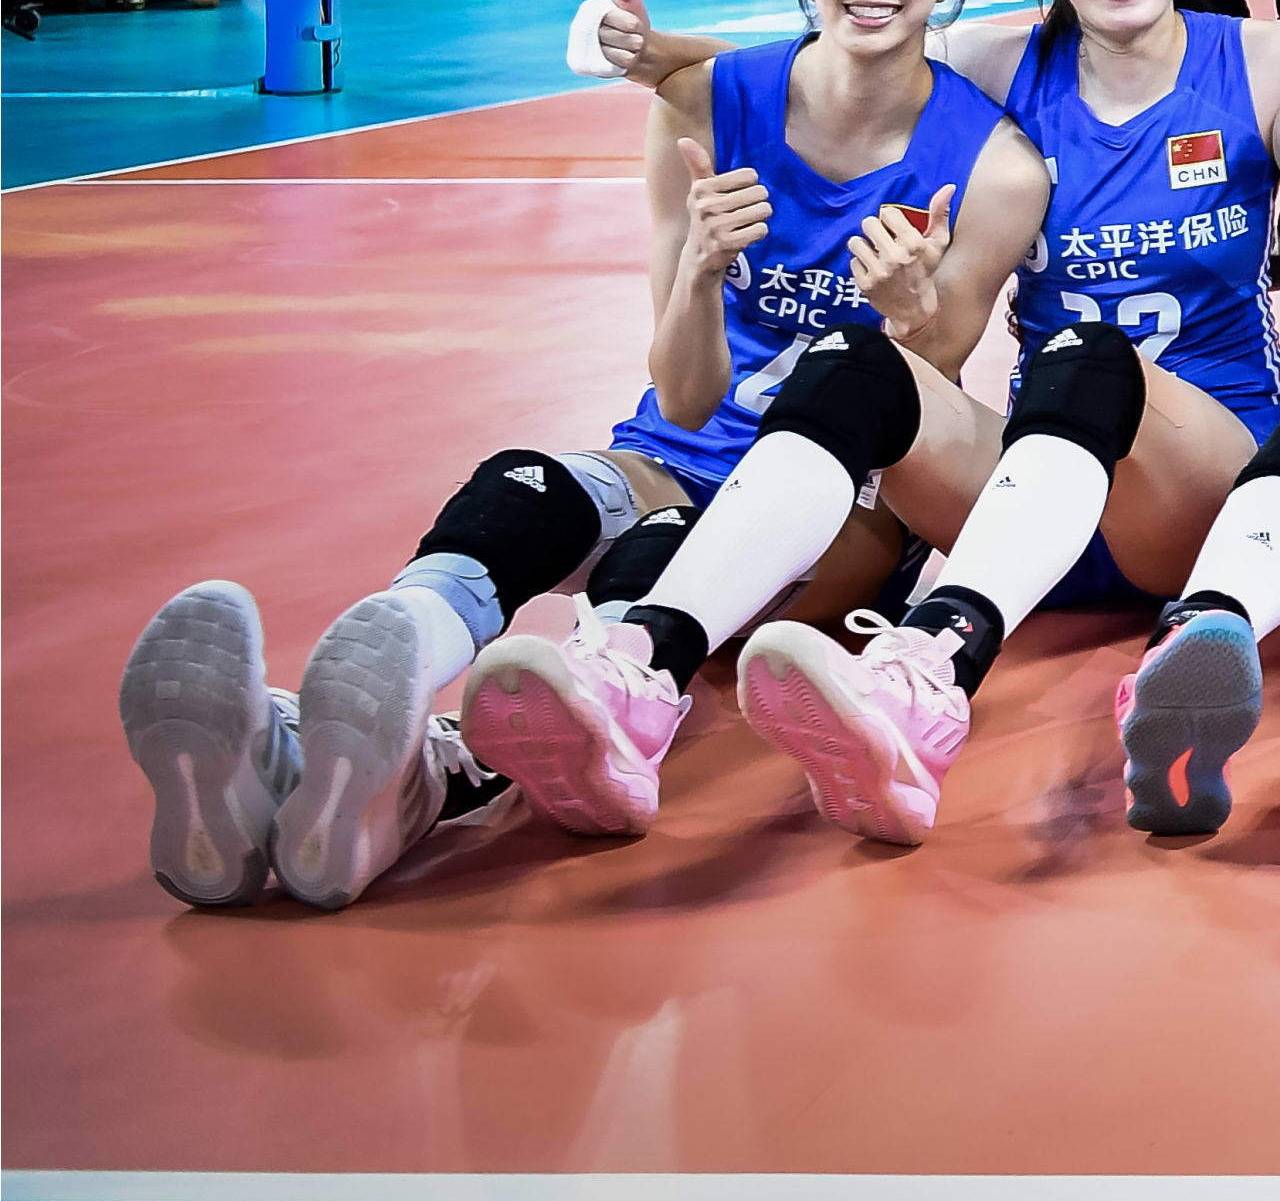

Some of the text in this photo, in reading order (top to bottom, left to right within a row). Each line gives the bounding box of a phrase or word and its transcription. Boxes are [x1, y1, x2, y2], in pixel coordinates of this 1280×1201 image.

[1178, 165, 1220, 183] CHN
[1060, 204, 1250, 259] 太平洋保险
[760, 263, 870, 309] 太平洋
[1066, 259, 1139, 280] CPIC
[758, 295, 828, 330] CPIC
